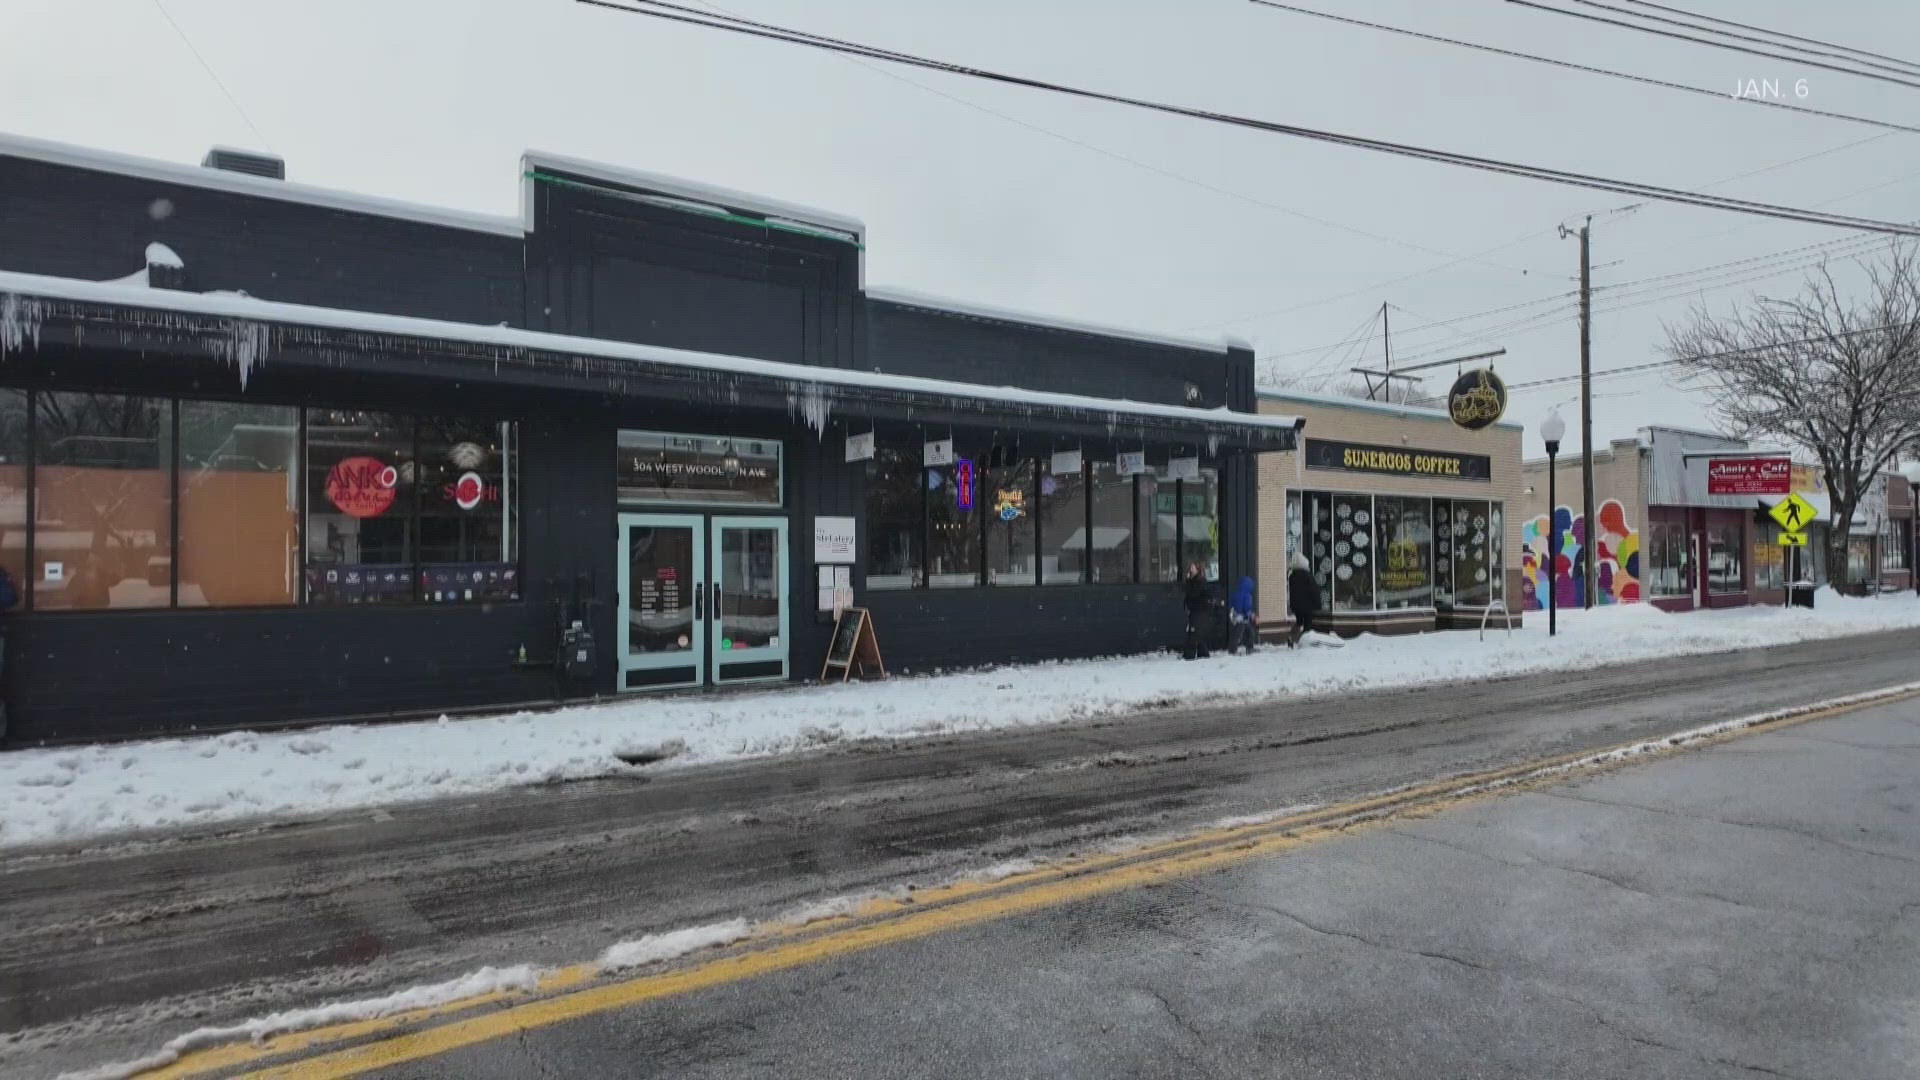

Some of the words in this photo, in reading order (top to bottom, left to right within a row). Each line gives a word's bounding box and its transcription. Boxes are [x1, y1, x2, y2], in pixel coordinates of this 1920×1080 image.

[1343, 447, 1411, 471] SUNERGOS
[1414, 454, 1460, 475] COFFEE
[1711, 463, 1756, 477] Annie's
[1761, 461, 1789, 478] Café
[655, 462, 684, 474] WEST
[685, 464, 747, 477] WOODLN
[748, 467, 767, 478] AVE
